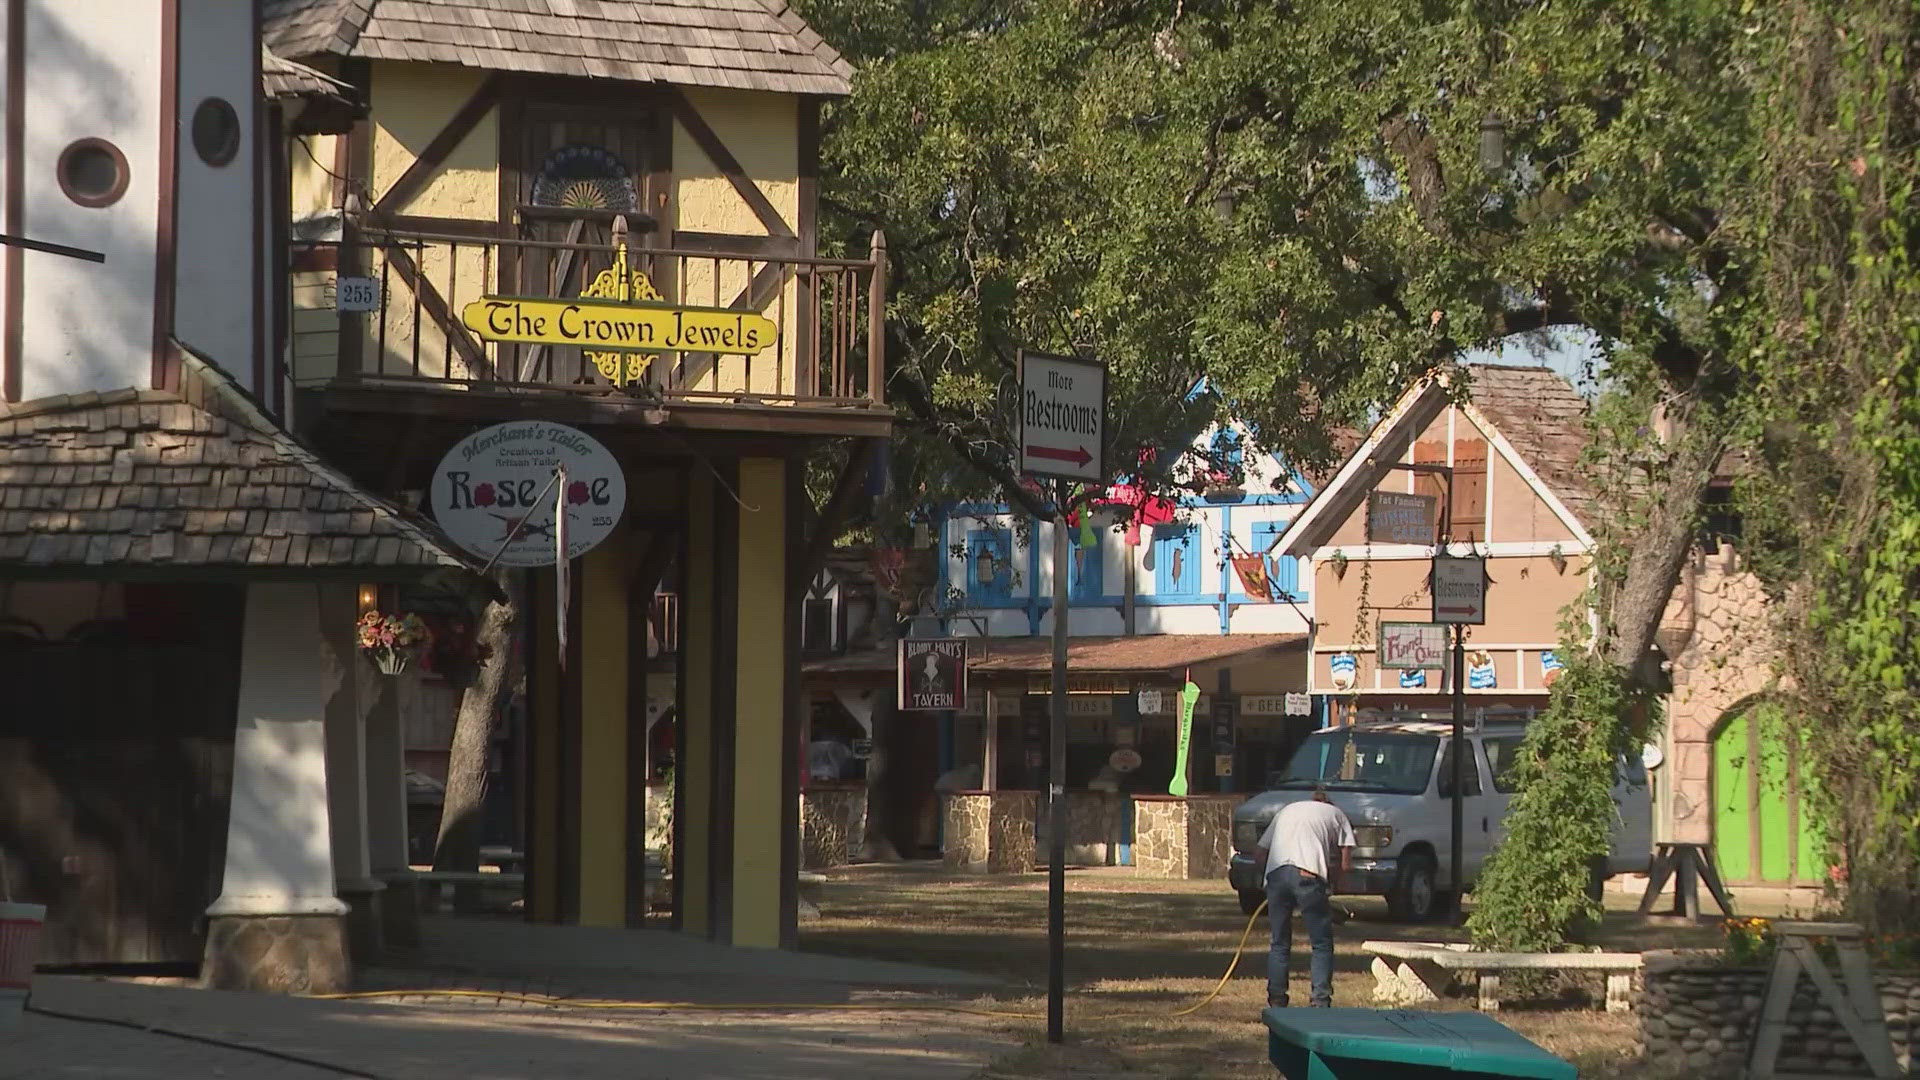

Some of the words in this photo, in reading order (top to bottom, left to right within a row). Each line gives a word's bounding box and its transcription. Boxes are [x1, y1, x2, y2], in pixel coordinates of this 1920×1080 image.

[344, 285, 372, 304] 255
[485, 302, 546, 337] The
[559, 305, 655, 343] Crown
[665, 312, 758, 348] Jewels
[1048, 369, 1073, 391] More
[1026, 389, 1097, 436] Restrooms
[462, 424, 545, 461] Merchant's
[548, 428, 592, 456] Tailor
[1437, 576, 1480, 598] Restrooms
[1385, 629, 1423, 664] Funnel
[913, 692, 953, 707] TAVERN
[1258, 699, 1283, 712] BEE
